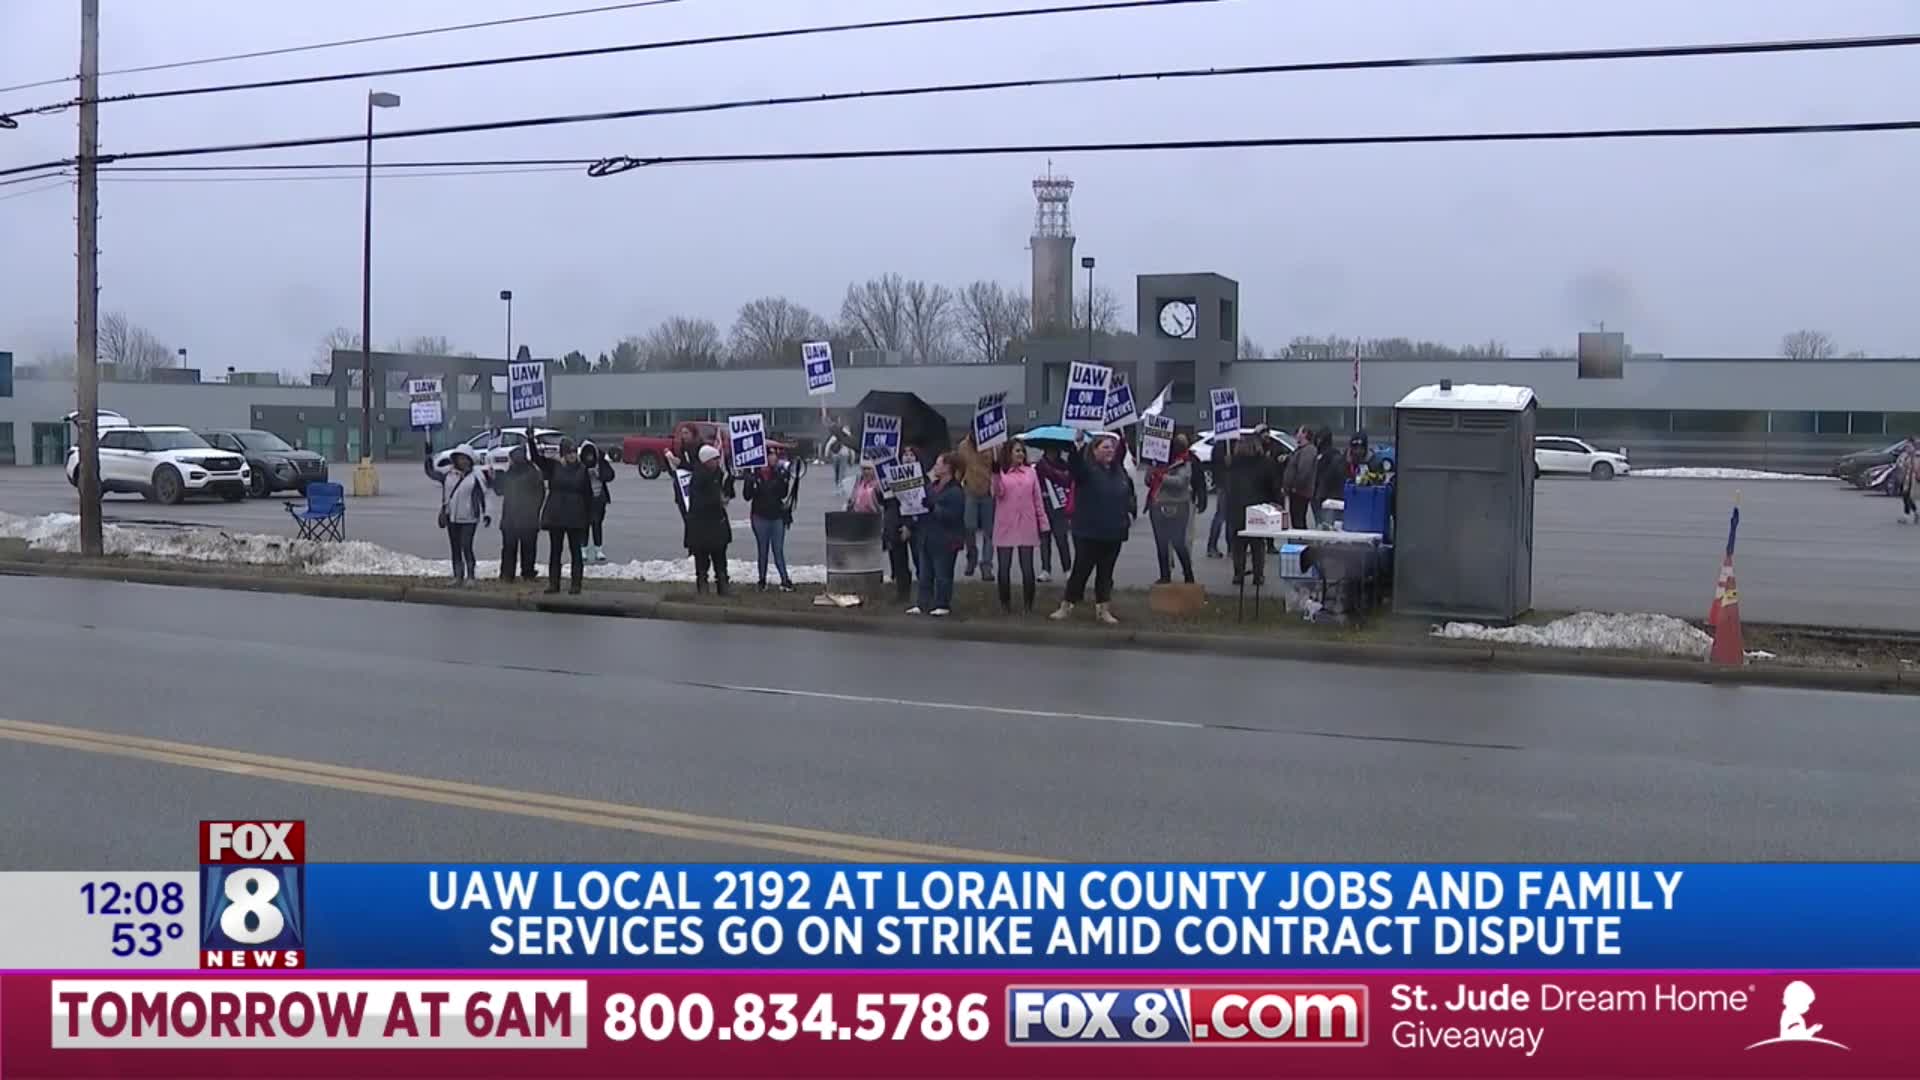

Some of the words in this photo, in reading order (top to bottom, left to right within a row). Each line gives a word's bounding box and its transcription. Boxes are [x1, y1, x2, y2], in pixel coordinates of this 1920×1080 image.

[511, 365, 540, 381] UAW
[1073, 365, 1108, 386] UAW
[414, 381, 437, 393] UAW
[513, 396, 544, 412] STRIKE
[978, 391, 1007, 410] UAW
[1078, 391, 1094, 404] ON
[1213, 390, 1235, 405] UAW
[1067, 403, 1103, 418] STRIKE
[731, 419, 760, 434] UAW
[867, 415, 897, 431] UAW
[1148, 414, 1169, 429] UAW
[742, 436, 754, 450] ON
[873, 433, 888, 446] ON
[735, 445, 763, 466] STRIKE
[890, 464, 914, 480] UAW
